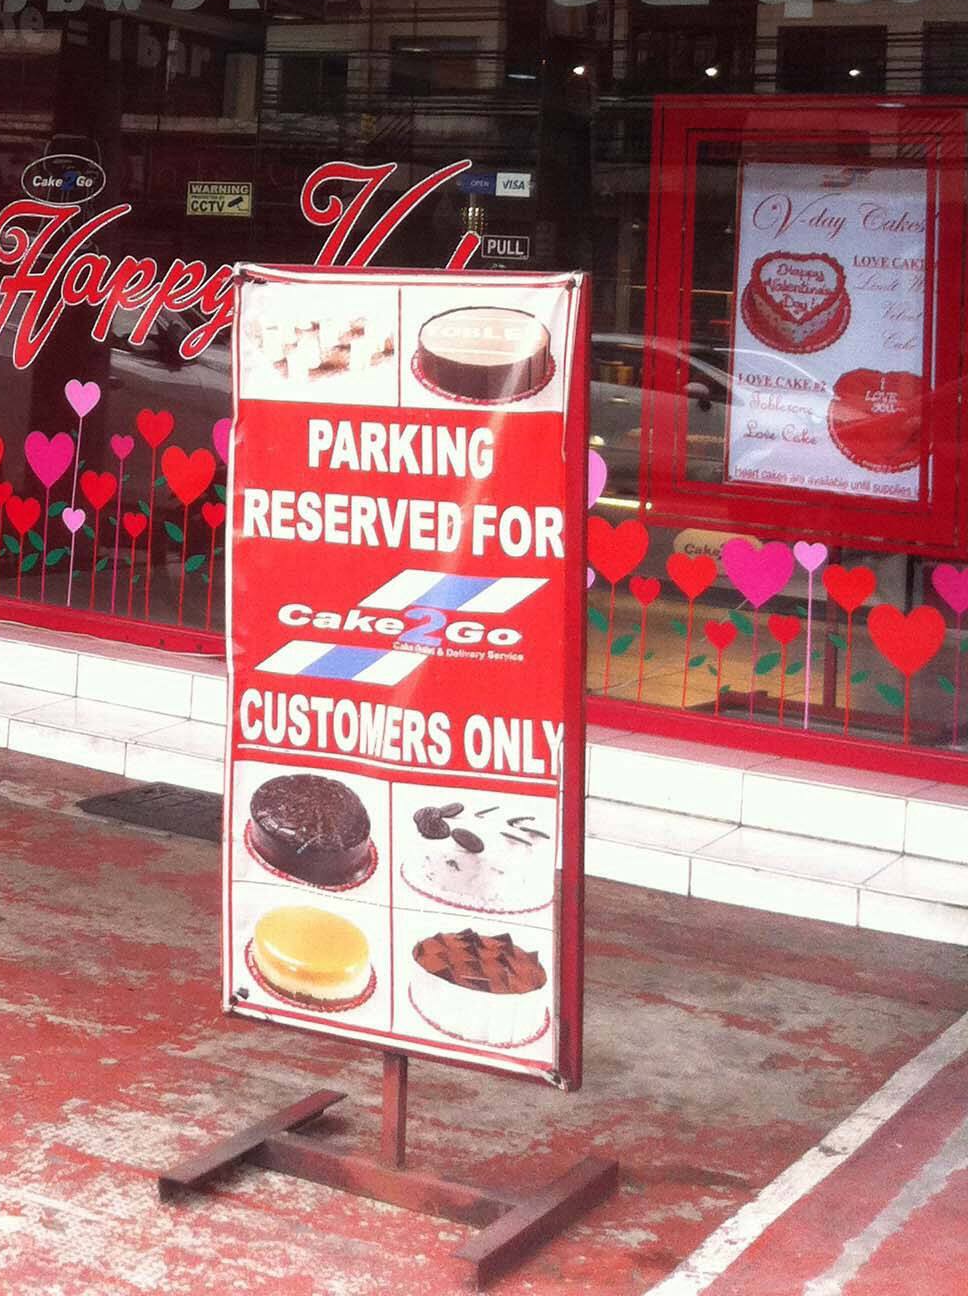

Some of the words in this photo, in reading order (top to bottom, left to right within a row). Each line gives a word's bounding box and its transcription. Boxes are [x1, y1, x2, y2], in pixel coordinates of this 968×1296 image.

[191, 184, 249, 194] WARNING
[470, 179, 490, 188] OPEN
[502, 179, 526, 191] VISA
[191, 200, 225, 212] CCTV
[487, 239, 524, 256] PULL
[853, 254, 889, 268] LOVE
[776, 263, 825, 282] Happy
[738, 373, 774, 388] LOVE
[776, 377, 812, 391] CAKE
[743, 420, 777, 440] Love
[781, 423, 817, 445] Cake
[308, 419, 495, 480] PARKING
[851, 478, 872, 491] until
[243, 488, 464, 553] RESERVED
[472, 504, 566, 559] FOR
[684, 544, 725, 560] Cake
[446, 648, 486, 661] Delivery
[487, 650, 525, 662] Service
[239, 688, 452, 766] CUSTOMERS
[464, 713, 565, 777] ONLY
